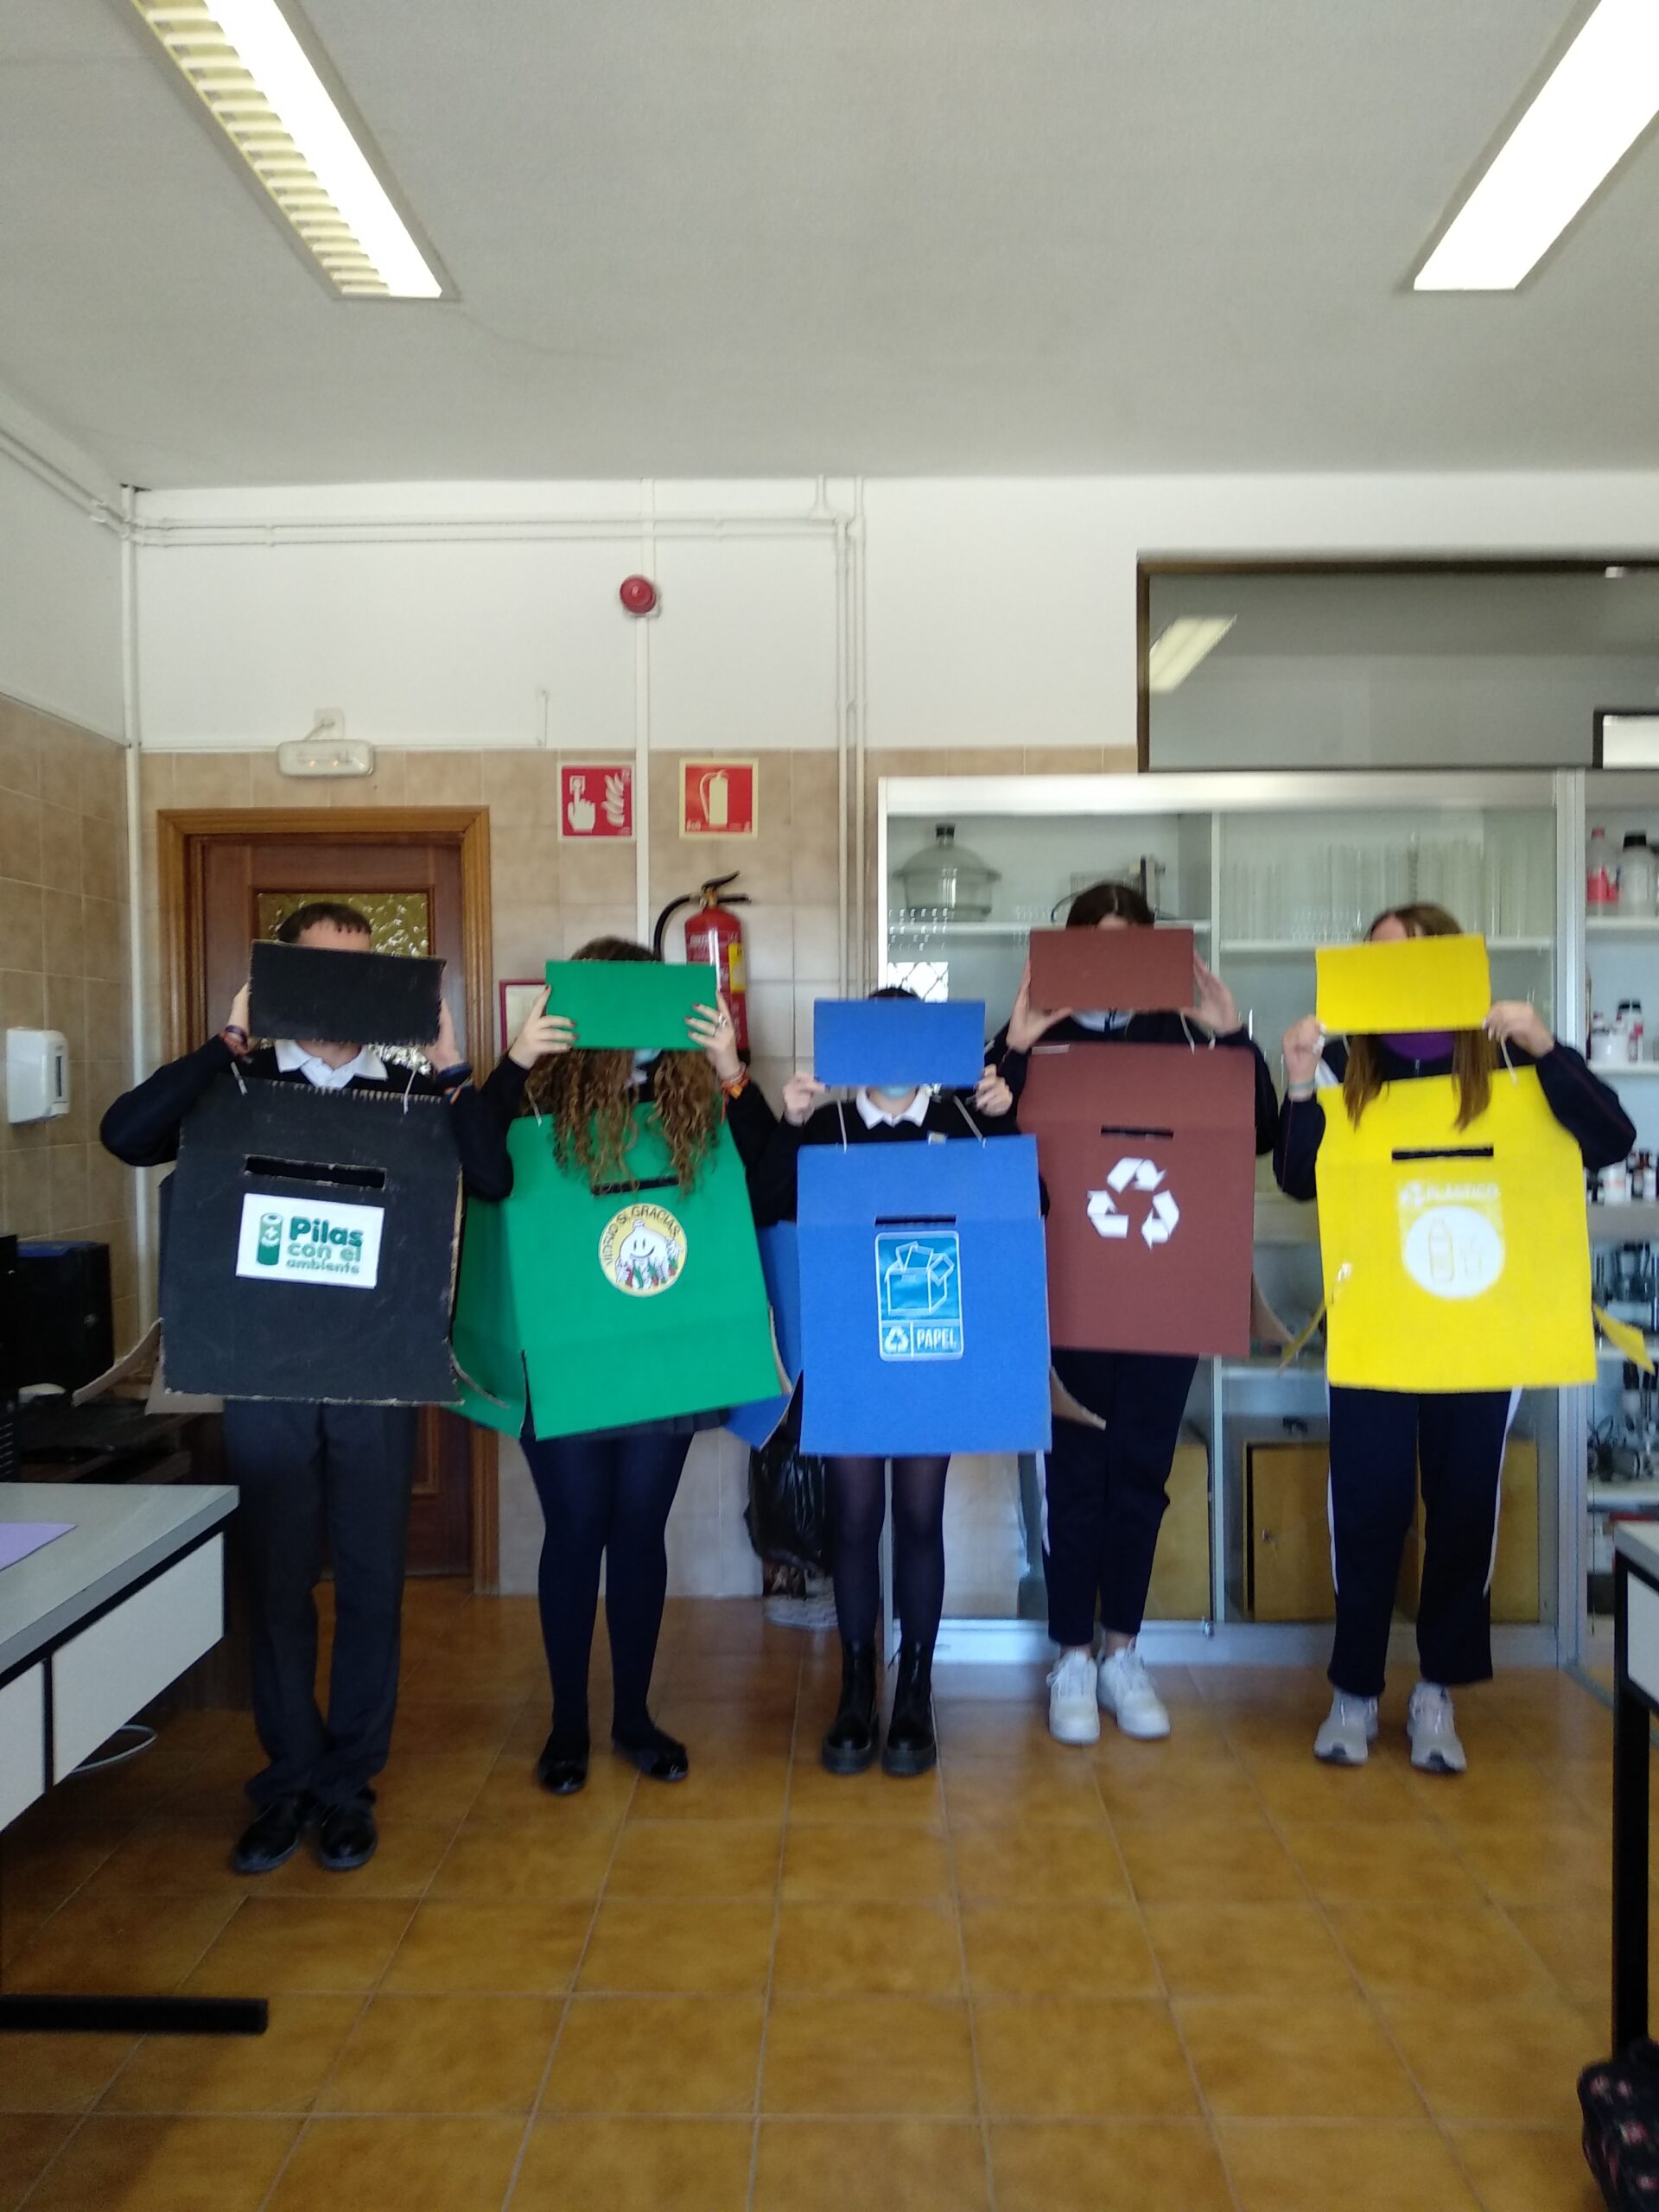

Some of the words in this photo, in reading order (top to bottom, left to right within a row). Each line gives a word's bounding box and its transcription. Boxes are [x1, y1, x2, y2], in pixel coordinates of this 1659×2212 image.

[289, 1217, 364, 1247] Pilas
[632, 1205, 680, 1236] GRACIAS
[288, 1243, 331, 1259] con
[340, 1246, 361, 1262] el
[286, 1259, 359, 1274] ambiente
[917, 1327, 957, 1350] PAPEL
